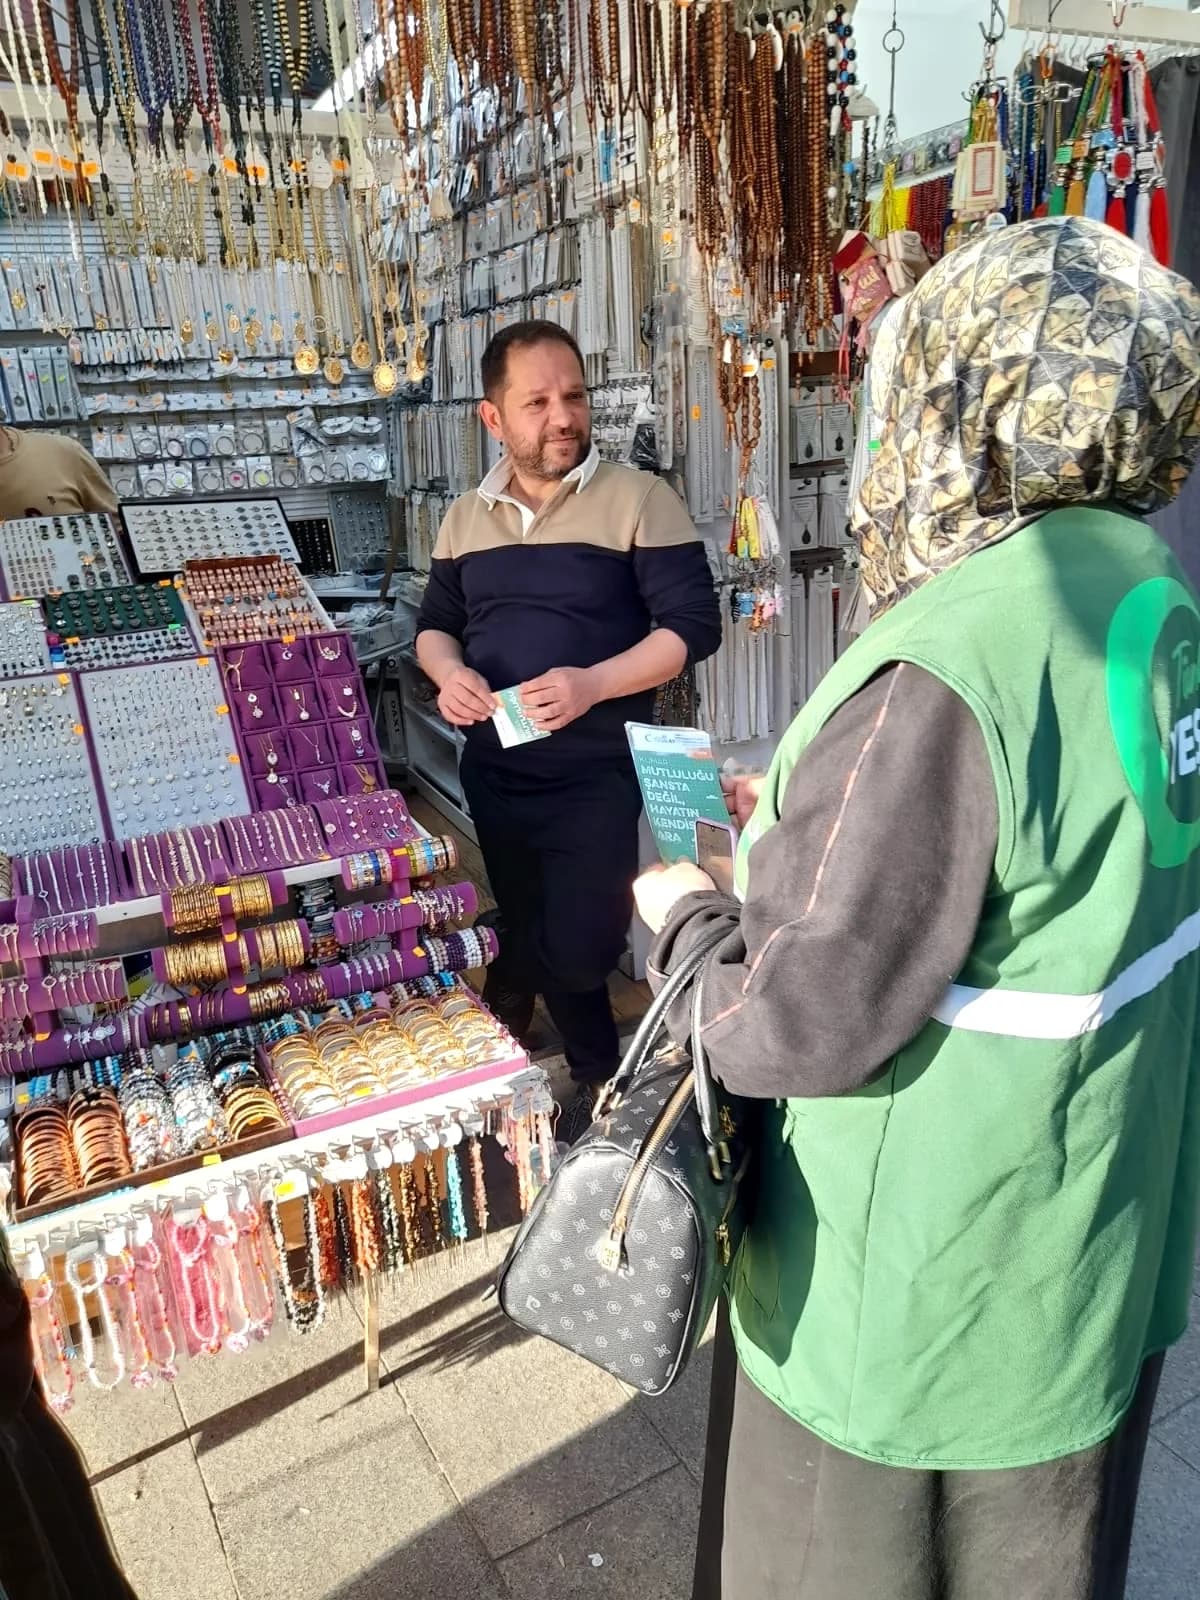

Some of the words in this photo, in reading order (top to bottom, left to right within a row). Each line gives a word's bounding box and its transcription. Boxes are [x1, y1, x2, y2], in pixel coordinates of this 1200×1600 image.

[641, 765, 714, 781] MUTLULUĞU
[643, 777, 691, 791] ŞANSTA
[646, 790, 686, 805] DEĞİL,
[649, 803, 699, 818] HAYATIN
[653, 816, 695, 830] KENDİS
[657, 830, 682, 842] ARA
